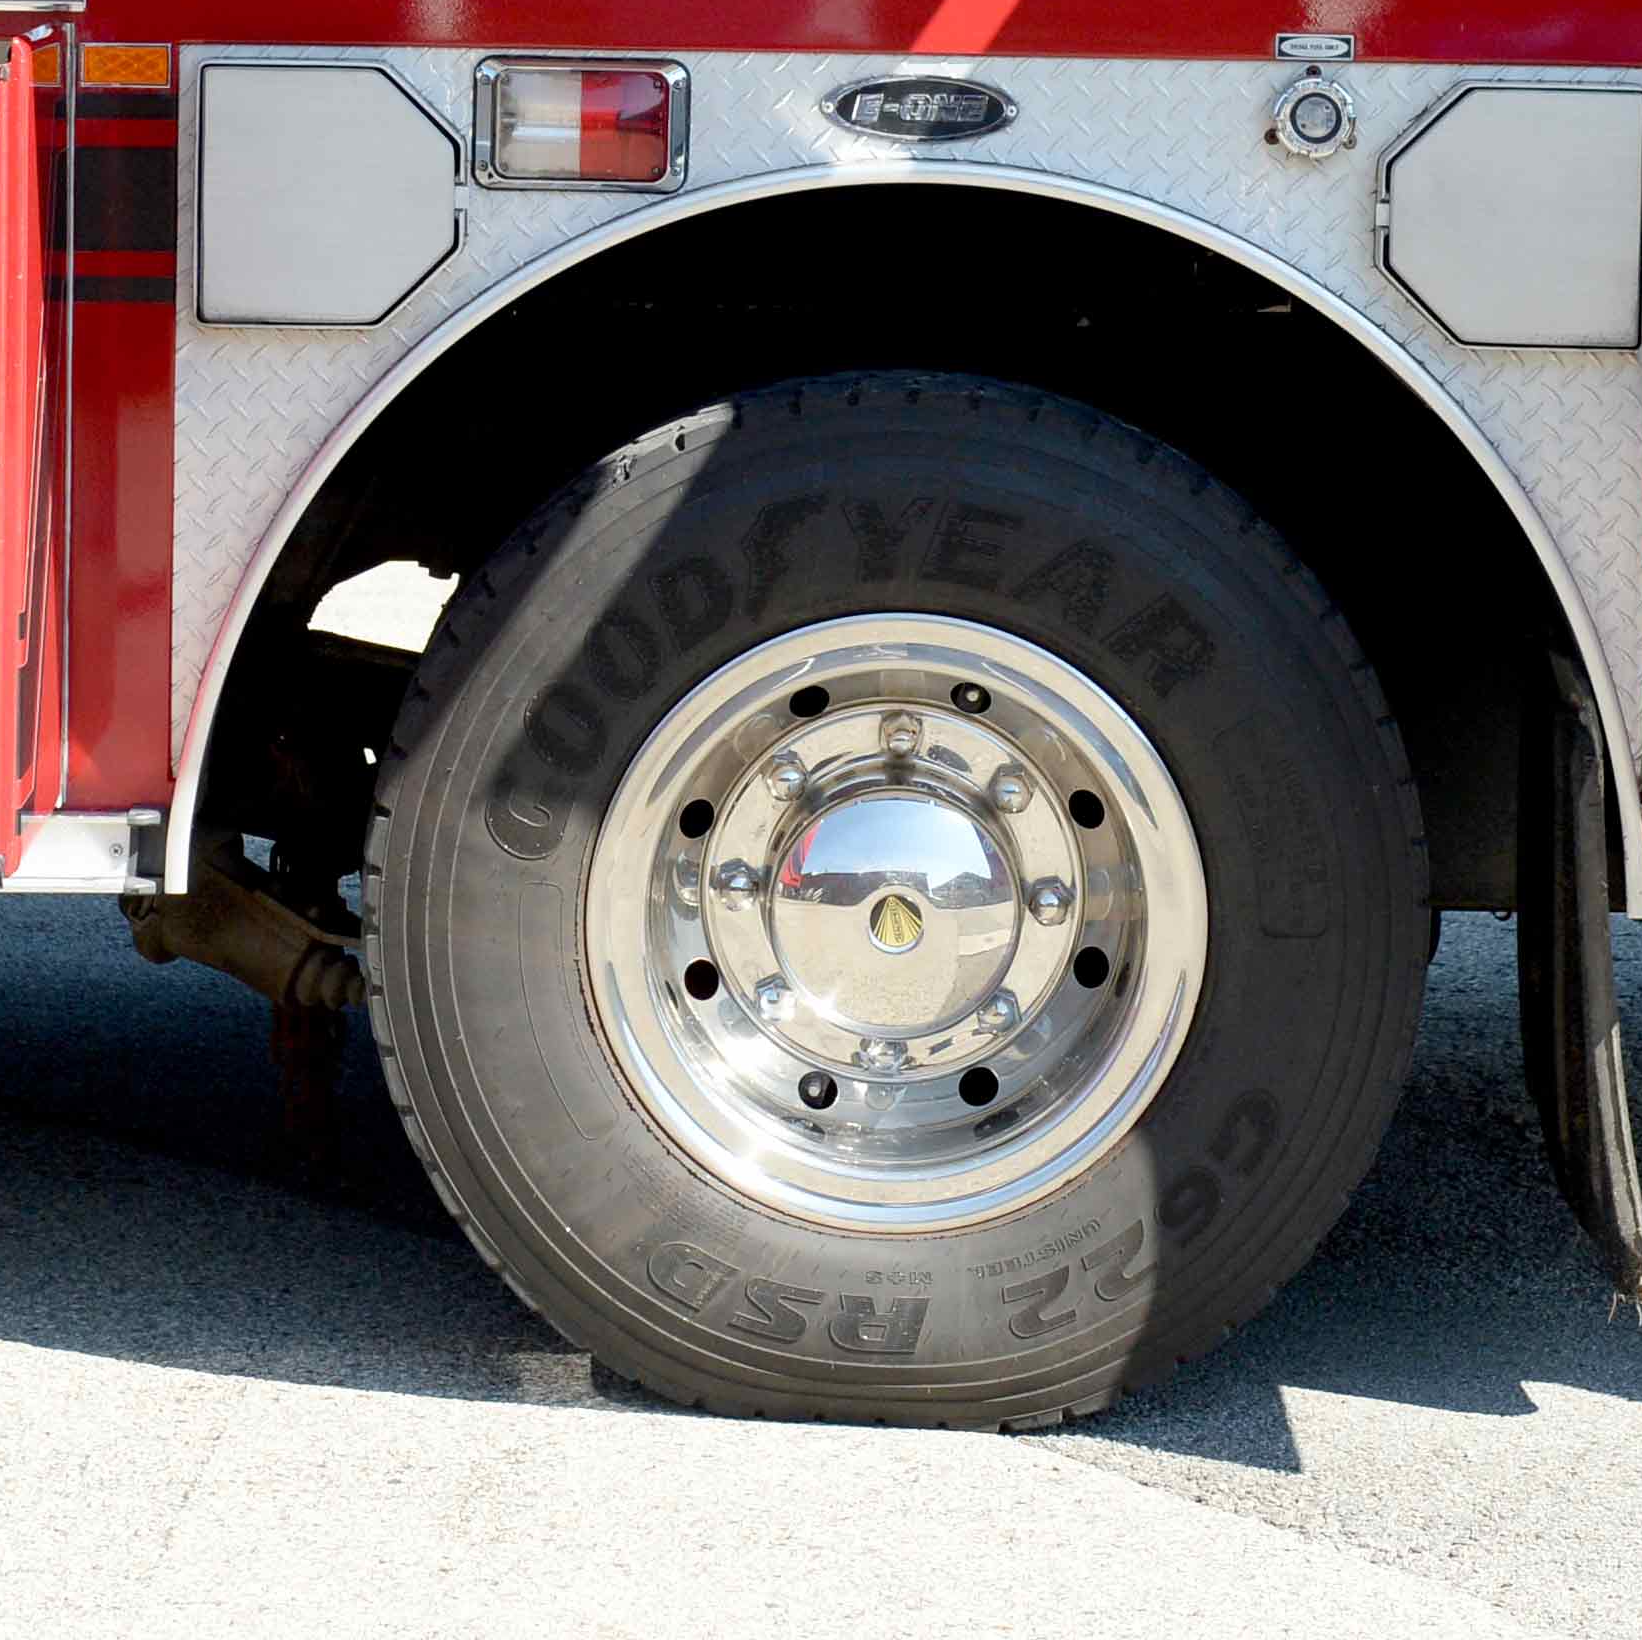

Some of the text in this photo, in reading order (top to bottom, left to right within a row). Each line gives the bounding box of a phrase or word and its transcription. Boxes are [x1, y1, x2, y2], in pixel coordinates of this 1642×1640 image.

[851, 91, 990, 124] E-ONE
[484, 492, 1217, 861] GOODYEAR
[646, 1240, 933, 1354] RSD
